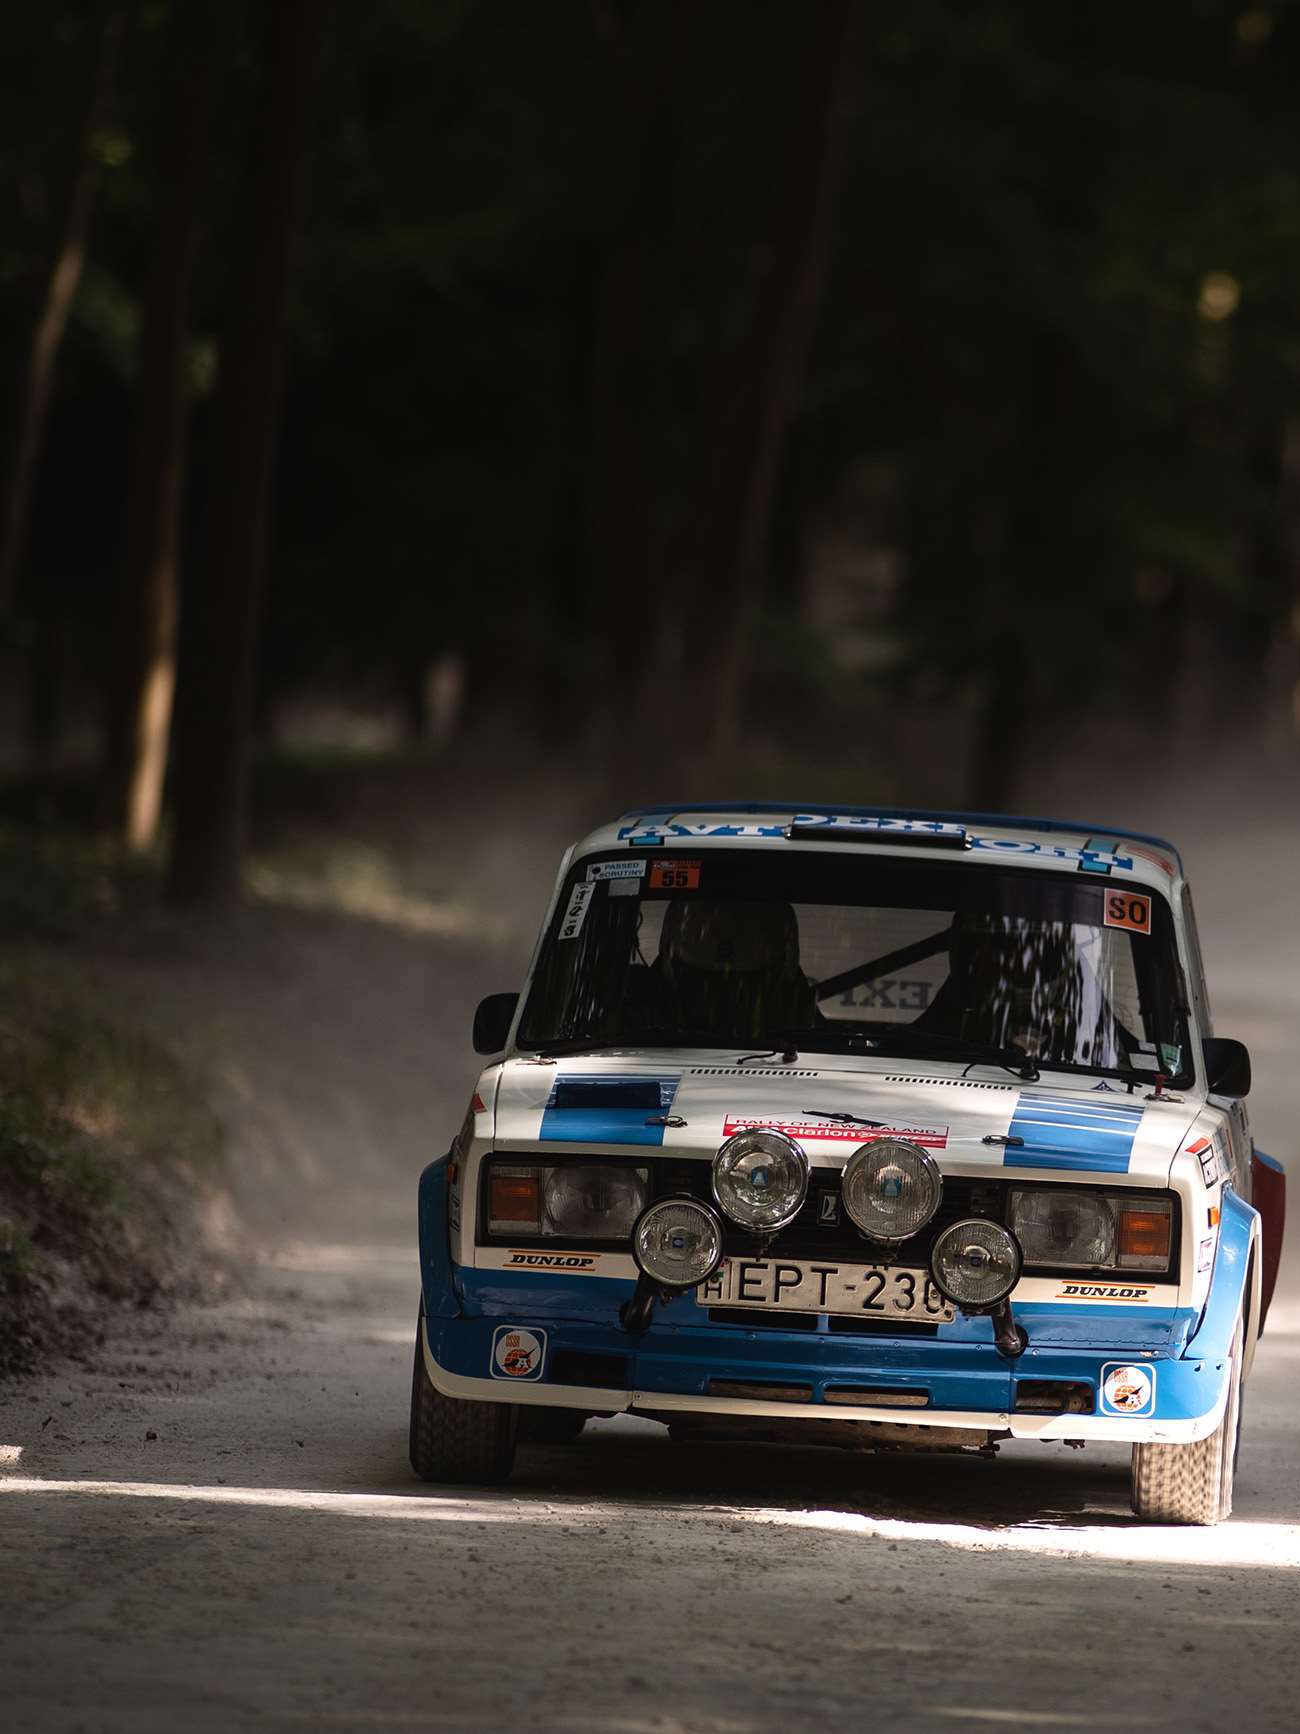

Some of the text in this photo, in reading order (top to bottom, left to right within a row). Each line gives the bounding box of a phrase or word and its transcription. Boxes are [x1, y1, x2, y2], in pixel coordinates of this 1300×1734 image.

[604, 862, 640, 870] PASSED
[600, 869, 644, 878] SCRUTINY
[661, 870, 689, 887] 55
[735, 1119, 785, 1127] RALLY
[817, 1122, 856, 1130] NEW
[783, 1126, 856, 1137] Clarion
[510, 1254, 594, 1267] DUNLOP
[704, 1281, 723, 1300] H
[1062, 1285, 1148, 1298] DUNLOP
